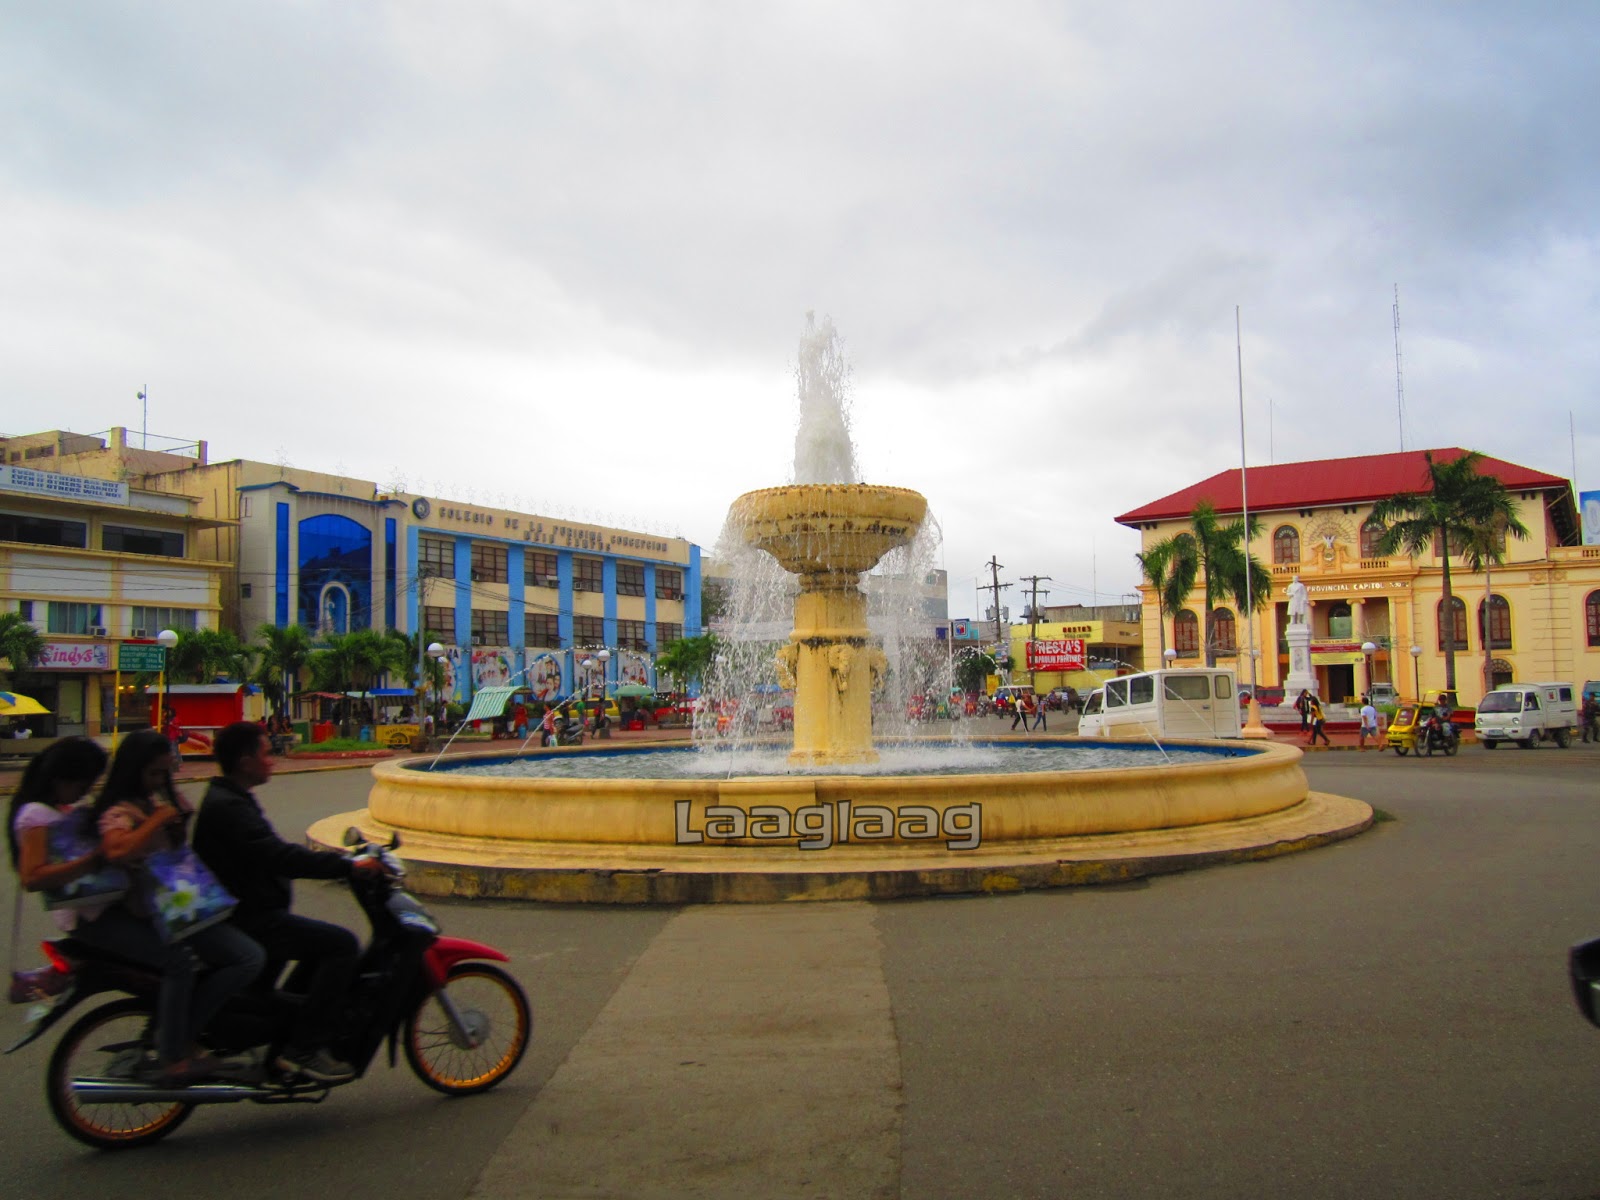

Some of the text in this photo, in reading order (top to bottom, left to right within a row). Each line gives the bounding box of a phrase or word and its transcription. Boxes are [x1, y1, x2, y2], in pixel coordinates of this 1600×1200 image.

[439, 506, 668, 552] COLEGIO DE LA PURISIMA CONCEPCION
[1307, 584, 1350, 593] PROVINCIAL
[1353, 582, 1385, 591] CAPITOL
[1029, 655, 1055, 664] TRPAULIN
